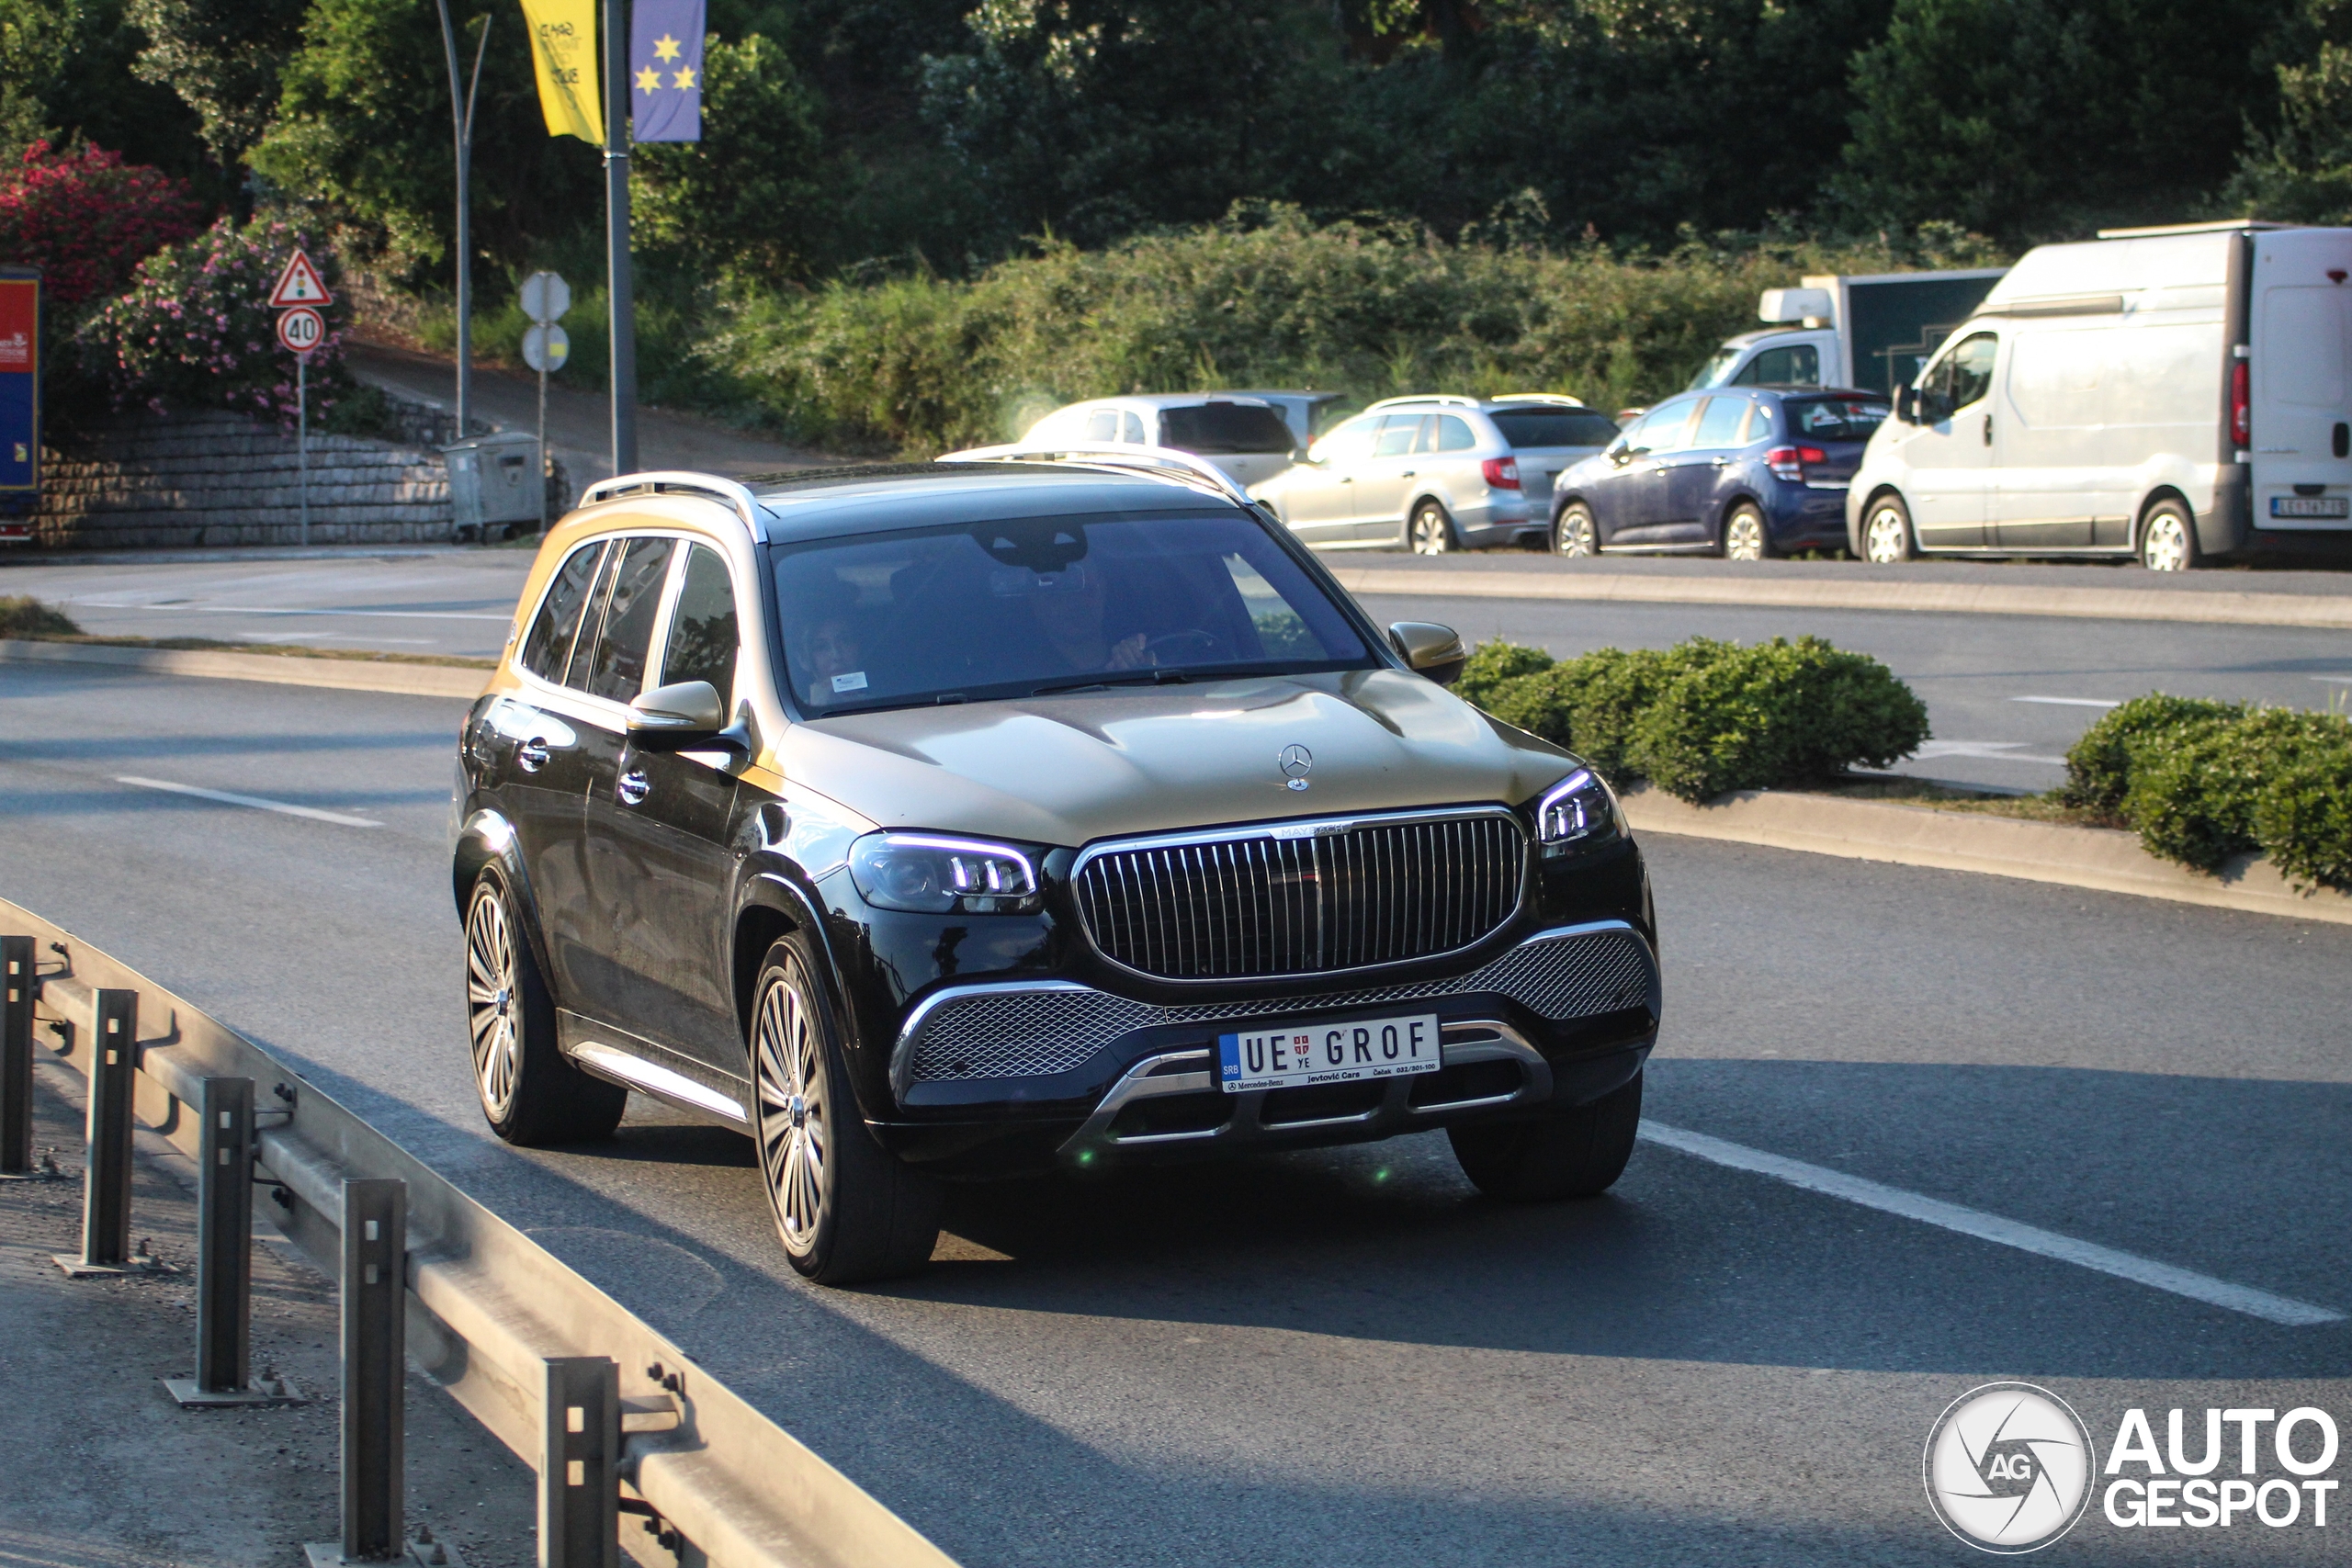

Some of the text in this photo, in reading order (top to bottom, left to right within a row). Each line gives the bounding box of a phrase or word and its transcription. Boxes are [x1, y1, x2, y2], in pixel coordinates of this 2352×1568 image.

[288, 318, 315, 341] 40
[1281, 823, 1344, 838] MAYBACH
[1246, 1021, 1423, 1073] UE GROF
[1223, 1065, 1239, 1076] SRB
[1238, 1079, 1284, 1090] Mercedes-Benz
[1307, 1073, 1340, 1084] Jevtović
[1341, 1071, 1361, 1080] Cars
